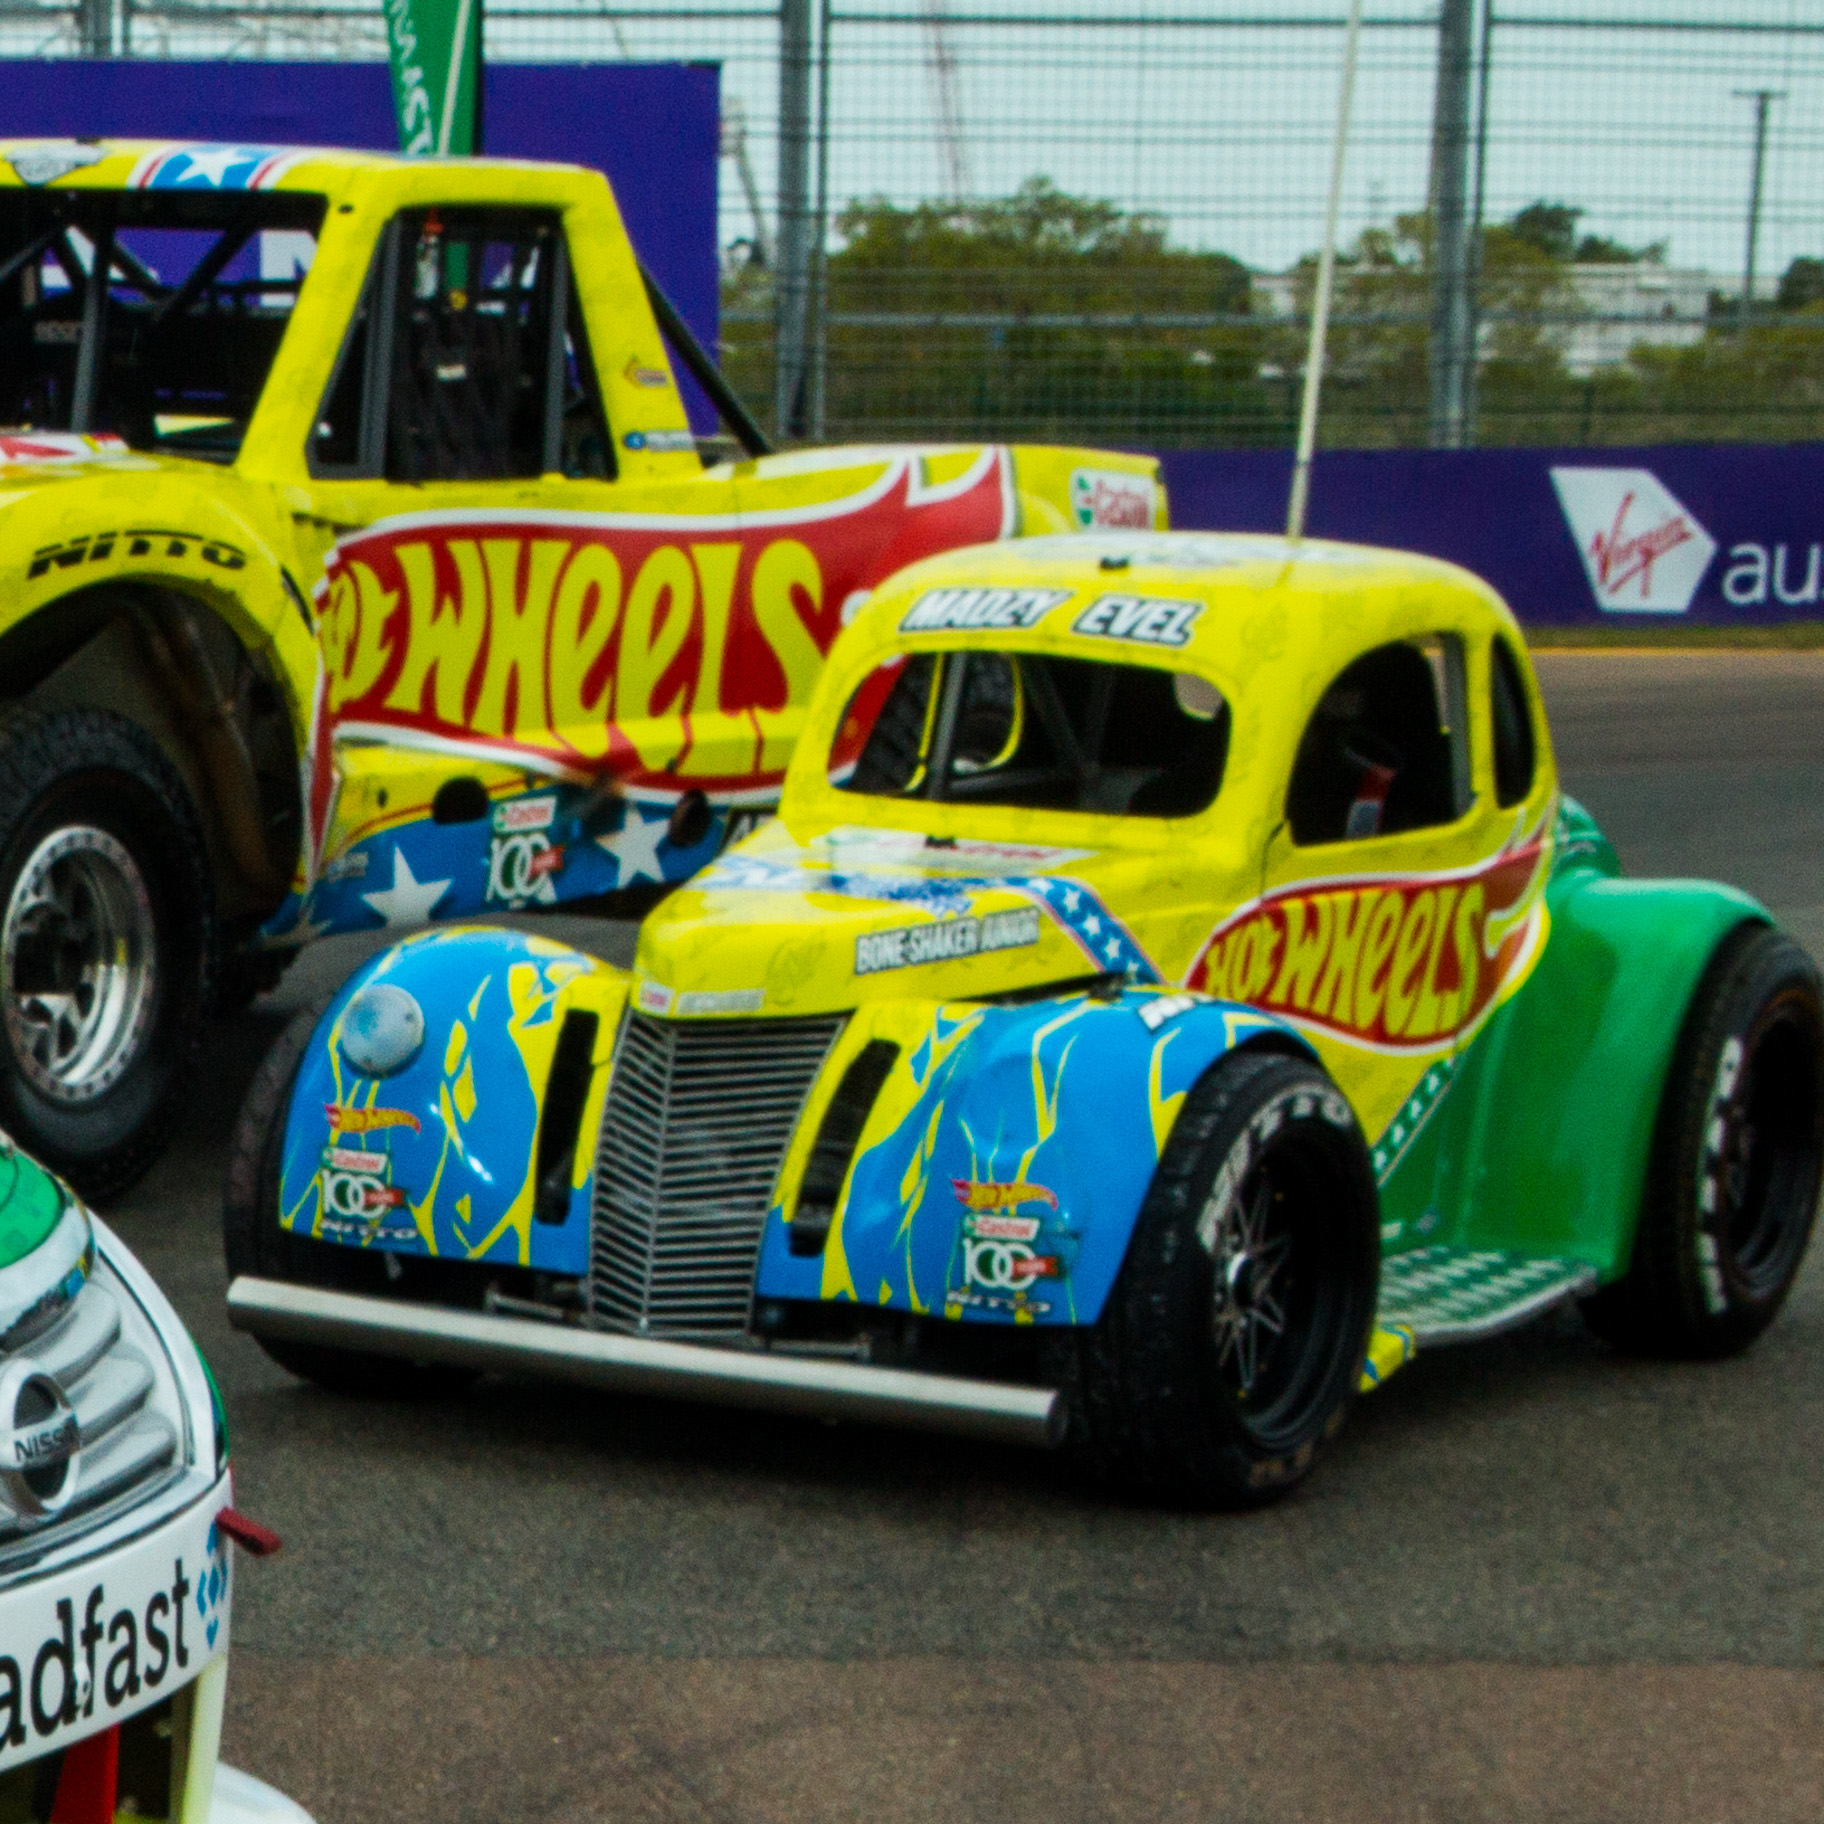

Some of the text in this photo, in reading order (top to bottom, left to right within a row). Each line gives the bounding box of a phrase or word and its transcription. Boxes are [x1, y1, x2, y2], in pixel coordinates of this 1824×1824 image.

[1722, 542, 1824, 605] au
[1078, 597, 1202, 645] EVEL
[1273, 882, 1488, 1039] WHEELS
[14, 1424, 74, 1463] NISS
